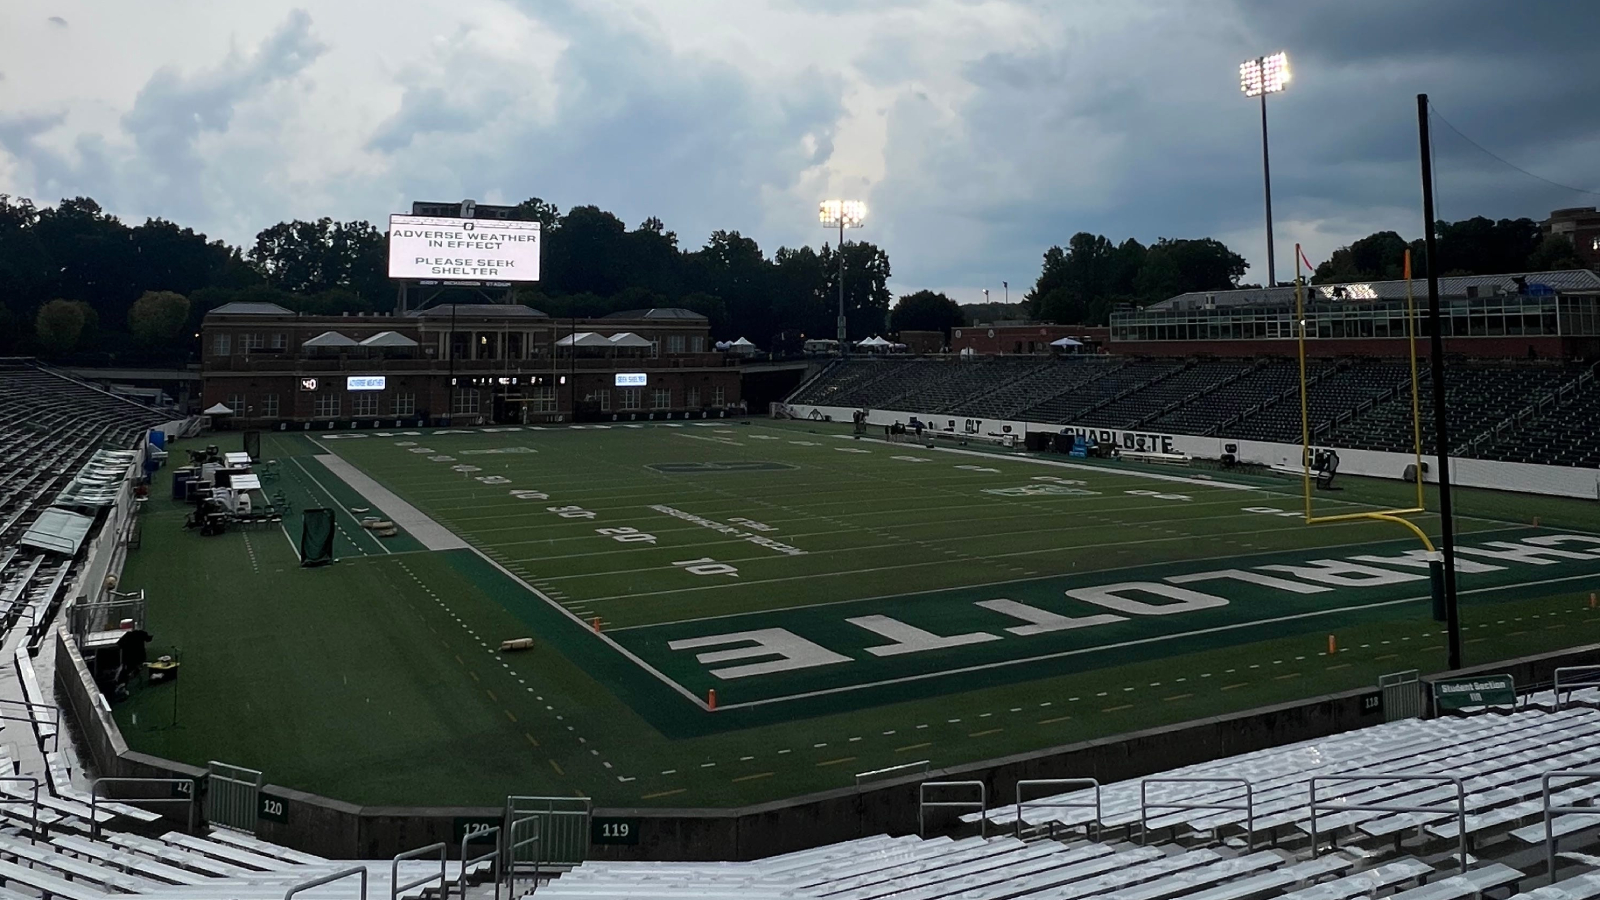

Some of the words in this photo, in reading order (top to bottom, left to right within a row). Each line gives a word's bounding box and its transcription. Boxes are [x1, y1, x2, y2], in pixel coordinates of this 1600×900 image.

[393, 230, 464, 240] ADVERSE
[467, 233, 536, 243] WEATHER
[428, 240, 443, 248] IN
[447, 241, 503, 250] EFFECT
[415, 257, 473, 267] PLEASE
[477, 259, 515, 268] SEEK
[431, 267, 499, 276] SHELTER
[302, 378, 317, 390] 40
[965, 418, 982, 434] CLT
[509, 489, 549, 500] 40
[546, 505, 597, 519] 30
[595, 527, 657, 543] 20
[671, 557, 739, 576] 10
[1441, 683, 1474, 693] Student
[1475, 680, 1506, 691] Section
[1365, 696, 1379, 709] 118
[264, 799, 283, 816] 120
[602, 823, 630, 837] 119
